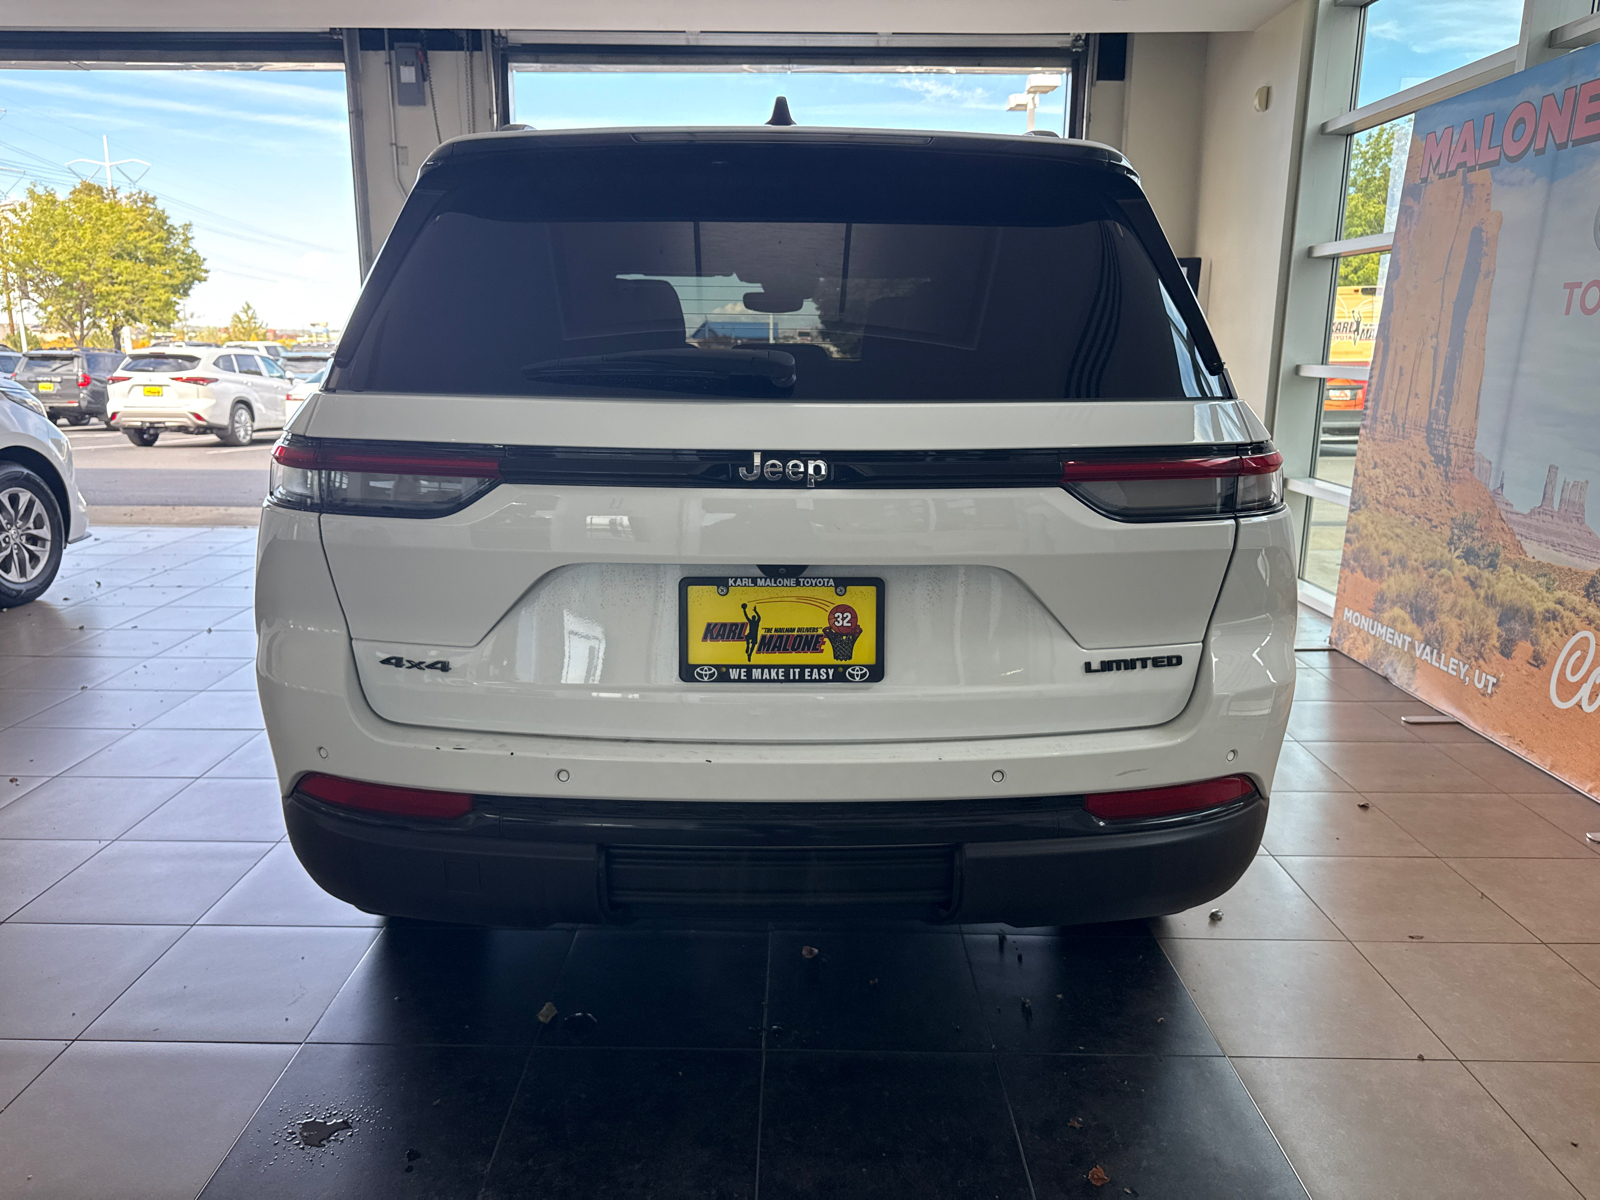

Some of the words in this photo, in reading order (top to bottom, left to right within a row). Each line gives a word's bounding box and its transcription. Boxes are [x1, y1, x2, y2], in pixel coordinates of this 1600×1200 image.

[1420, 77, 1600, 183] MALONE
[738, 451, 828, 488] Jeep
[728, 578, 754, 587] KARL
[756, 578, 797, 587] MALONE
[798, 578, 835, 587] TOYOTA
[834, 612, 852, 627] 32
[701, 622, 749, 642] KARL
[756, 634, 826, 654] MALONE
[1343, 607, 1412, 652] MONUMENT
[1414, 642, 1471, 685] VALLEY,
[1473, 669, 1497, 694] UT
[729, 668, 747, 680] WE
[752, 668, 785, 680] MAKE
[790, 668, 800, 680] IT
[805, 668, 834, 680] EASY
[1085, 655, 1182, 673] LIMITED
